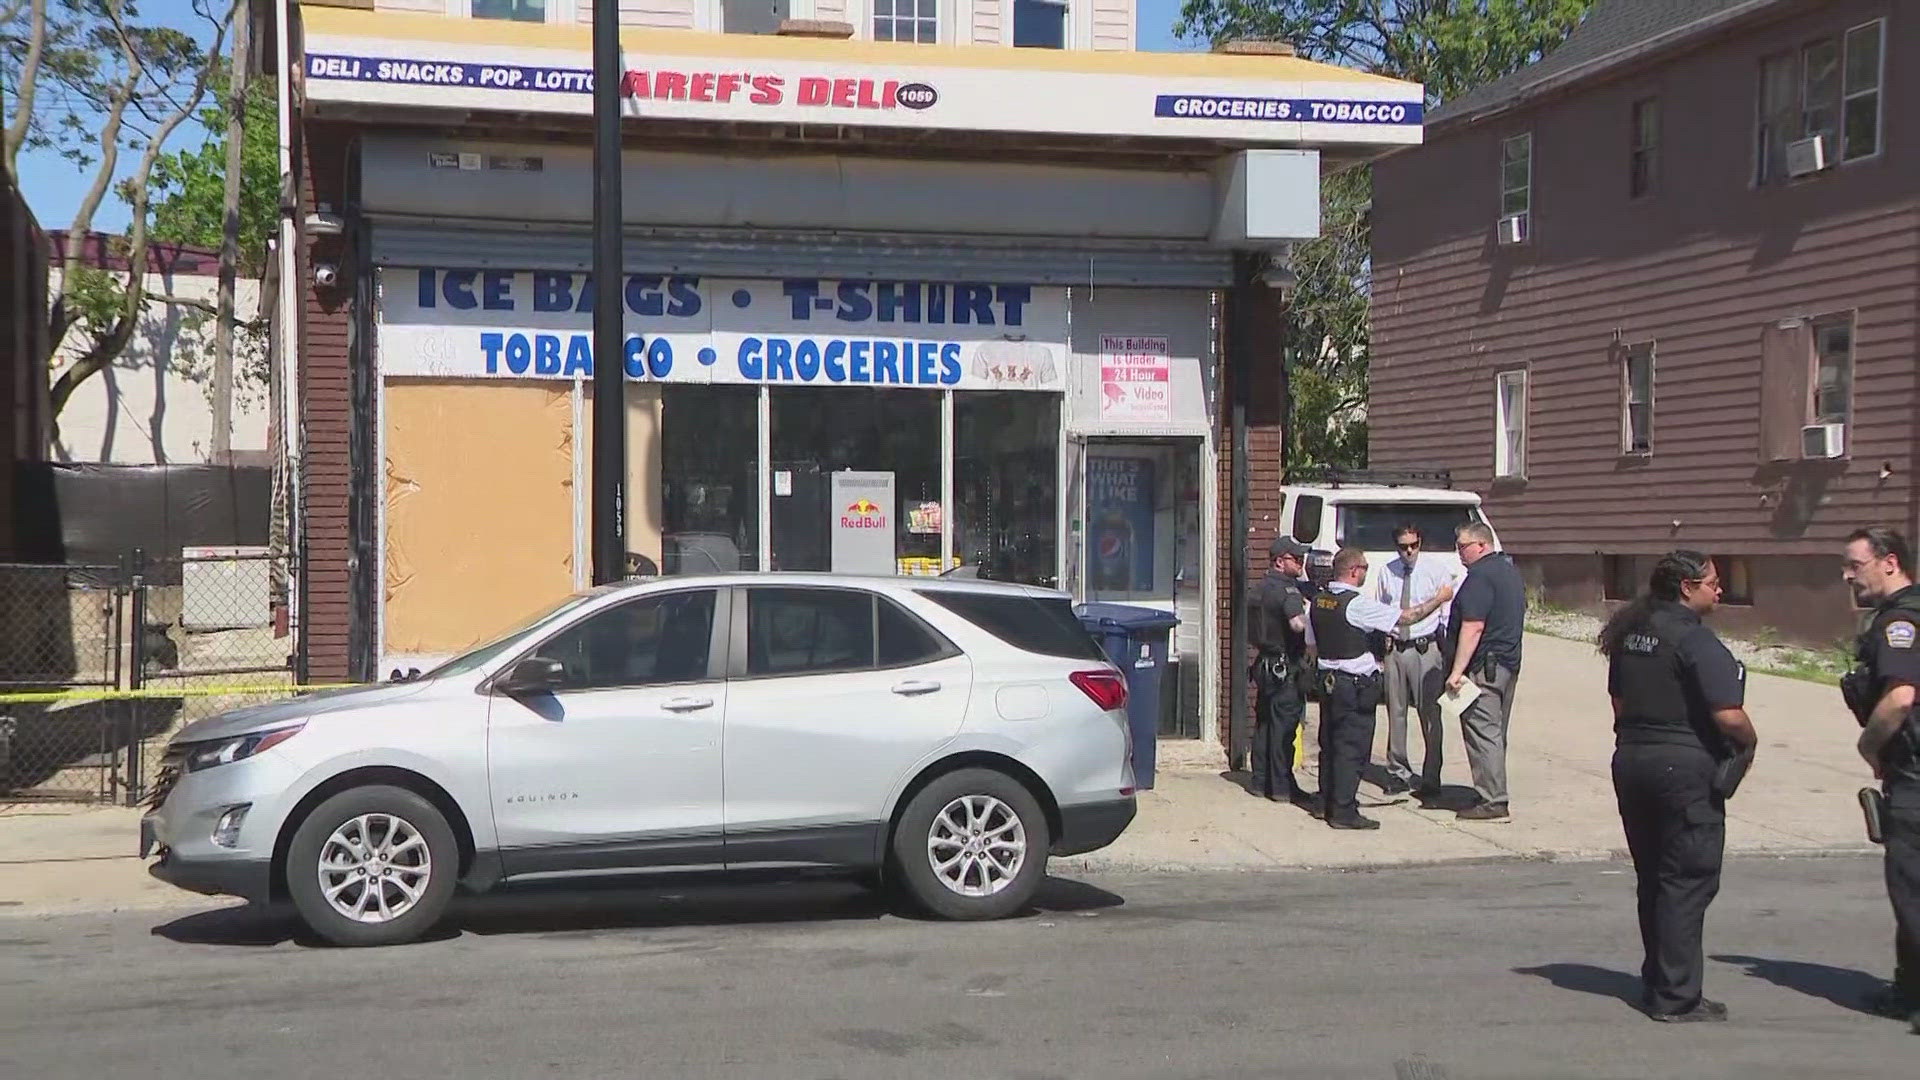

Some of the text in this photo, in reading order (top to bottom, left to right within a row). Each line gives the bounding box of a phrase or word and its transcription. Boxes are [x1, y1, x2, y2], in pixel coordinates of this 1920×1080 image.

[311, 57, 360, 78] DELI
[376, 61, 464, 84] SNACKS
[620, 70, 899, 109] AREF'S DELI
[1173, 98, 1406, 122] GROCERIES TOBACCO
[418, 267, 515, 311] ICE
[782, 281, 1031, 326] T-SHIRT
[1104, 339, 1166, 352] This Building
[480, 332, 963, 384] TOBACO GROCERIES
[1125, 353, 1156, 364] Under
[1114, 369, 1156, 381] 24 Hour
[1134, 387, 1164, 400] Video
[1090, 460, 1139, 472] THAT'S
[1092, 473, 1137, 486] WHAT
[841, 516, 886, 528] Red Bull
